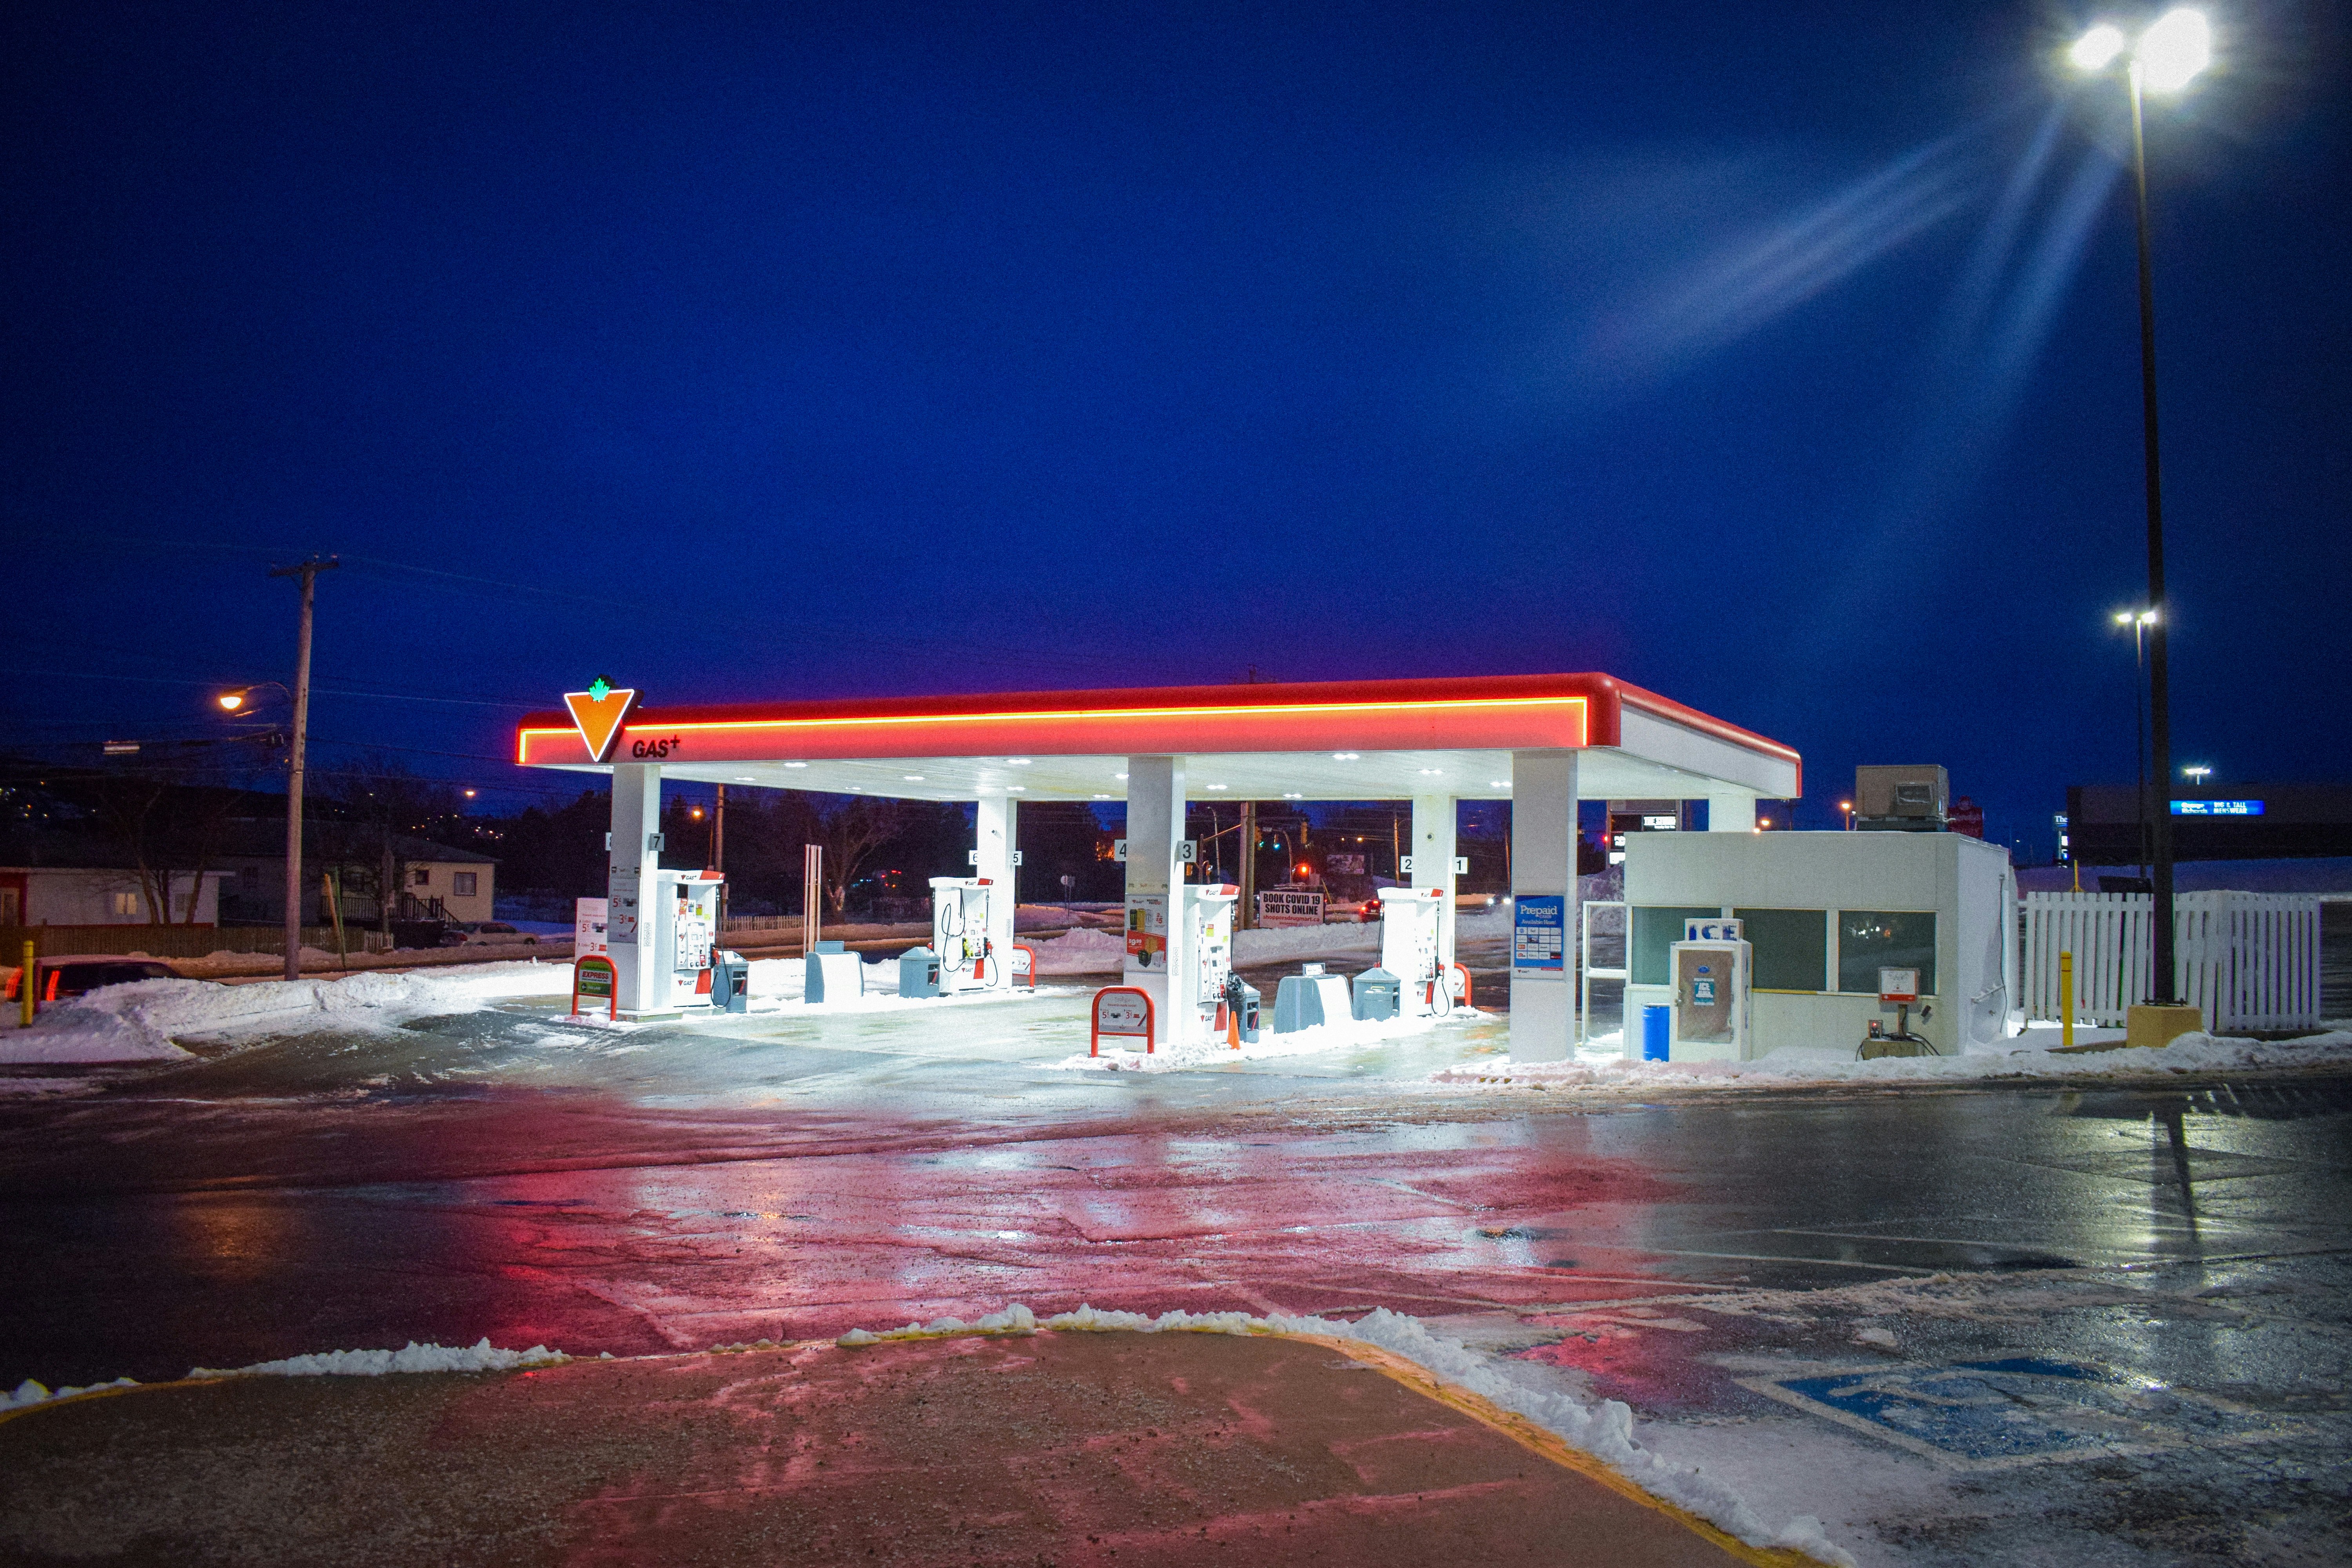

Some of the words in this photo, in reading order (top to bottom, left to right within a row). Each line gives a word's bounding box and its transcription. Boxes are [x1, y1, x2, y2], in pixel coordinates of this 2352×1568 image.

[653, 836, 661, 848] 7
[1119, 843, 1127, 857] 4
[1182, 844, 1192, 858] 3
[1013, 853, 1018, 863] 5
[1405, 859, 1412, 869] 2
[1456, 860, 1461, 871] 1
[1263, 893, 1284, 903] BOOK
[1286, 894, 1310, 904] COVID
[1311, 895, 1321, 905] 19
[1265, 903, 1290, 914] SHOTS
[1292, 904, 1318, 915] ONLINE
[1520, 905, 1558, 917] Prepaid
[1689, 925, 1737, 941] ICE
[582, 971, 609, 979] EXPRESS
